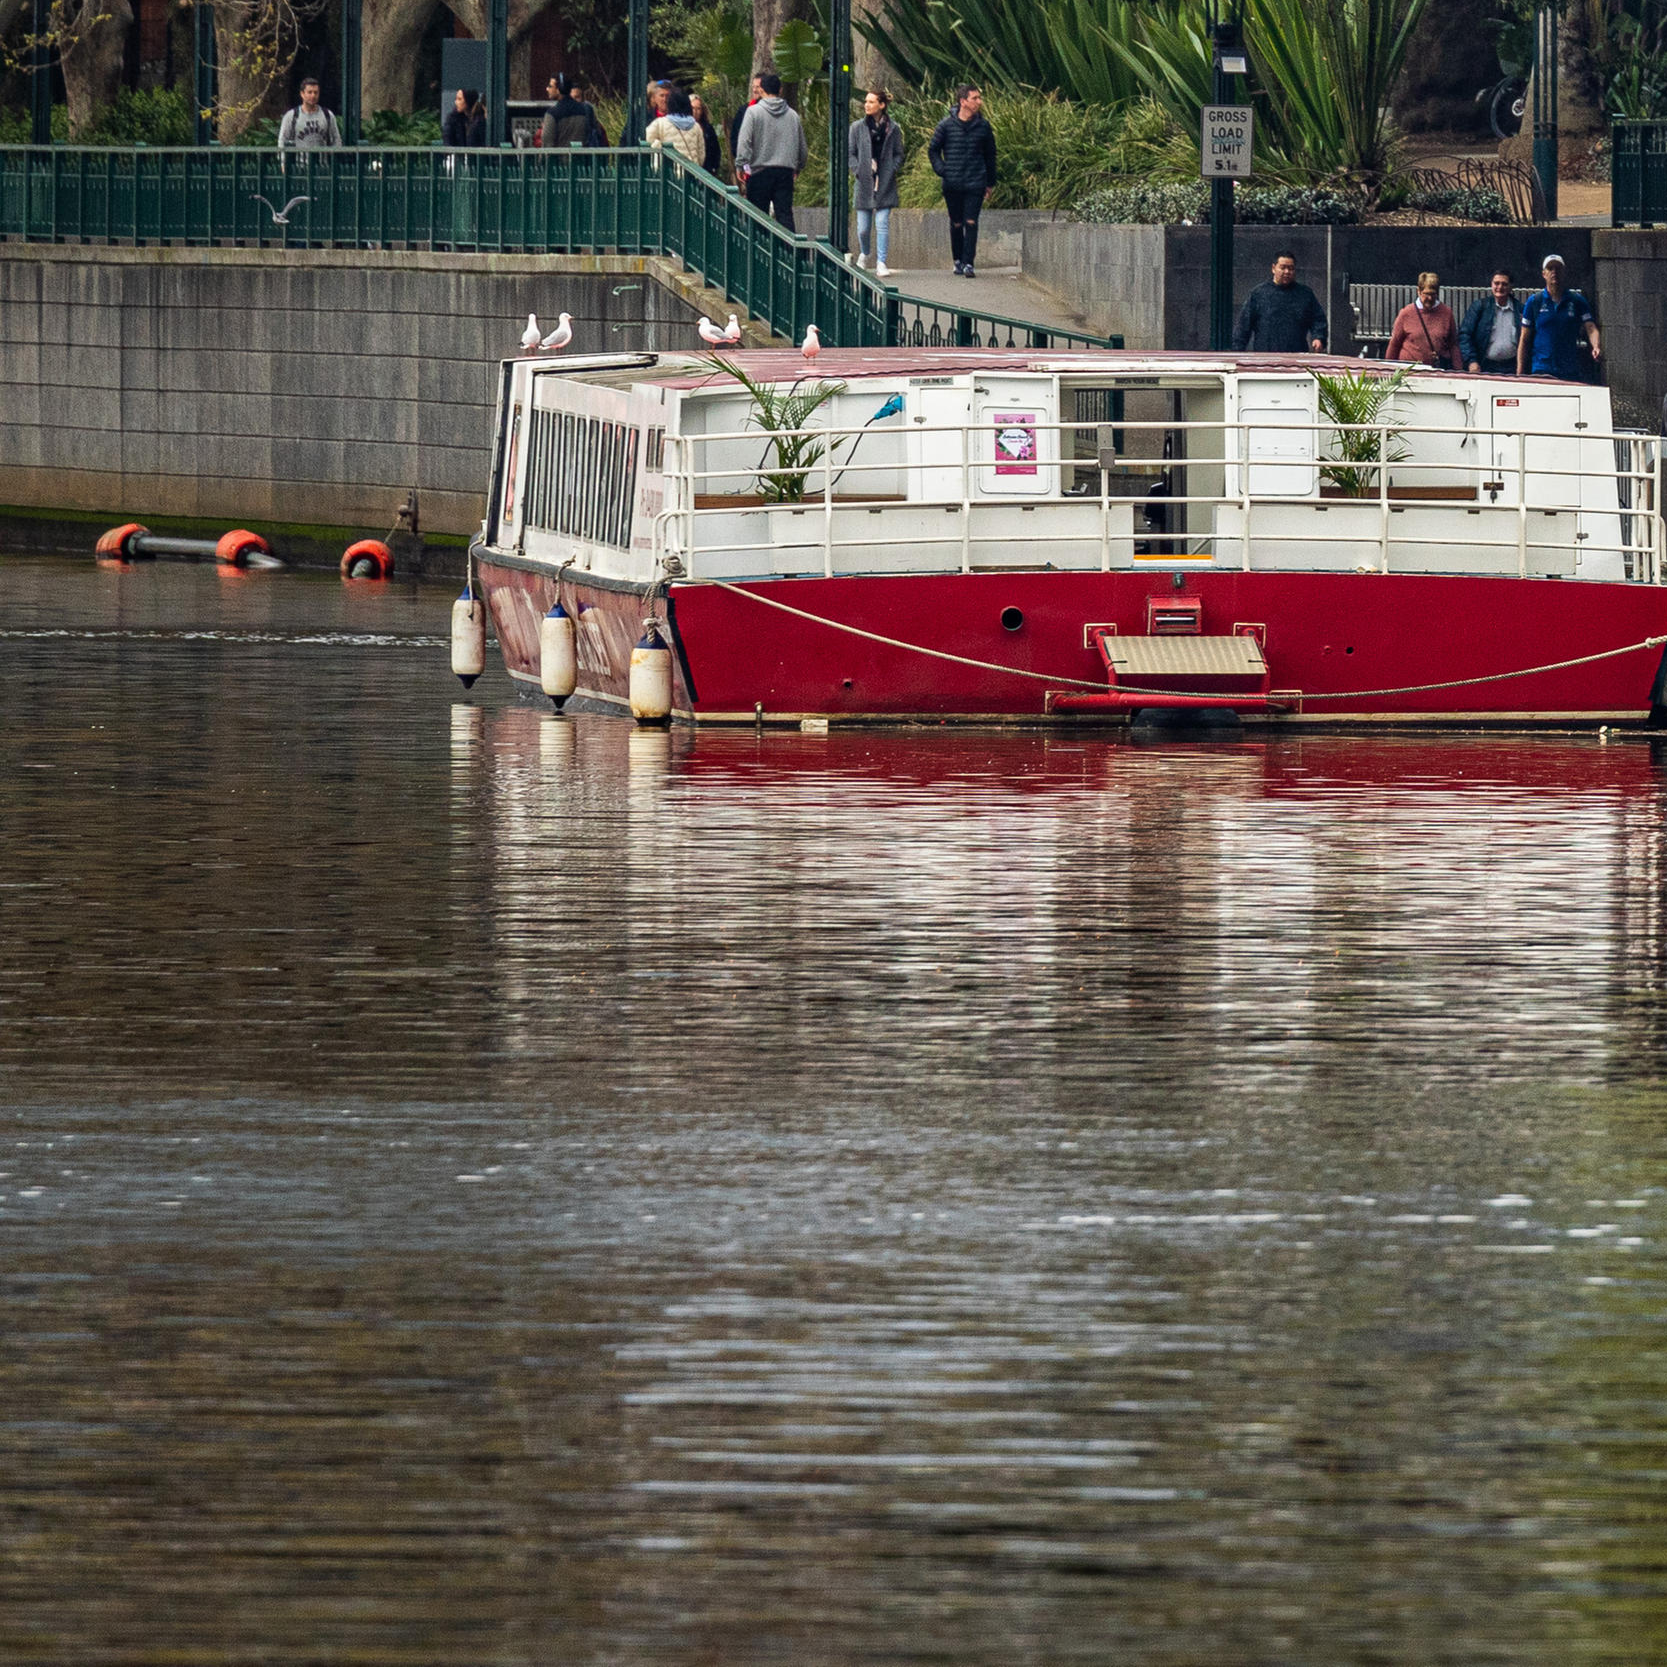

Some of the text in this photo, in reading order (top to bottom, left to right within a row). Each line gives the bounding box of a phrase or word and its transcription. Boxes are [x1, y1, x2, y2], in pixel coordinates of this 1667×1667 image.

[1208, 111, 1247, 122] GROSS
[1211, 127, 1243, 138] LOAD
[1212, 144, 1241, 155] LIMIT
